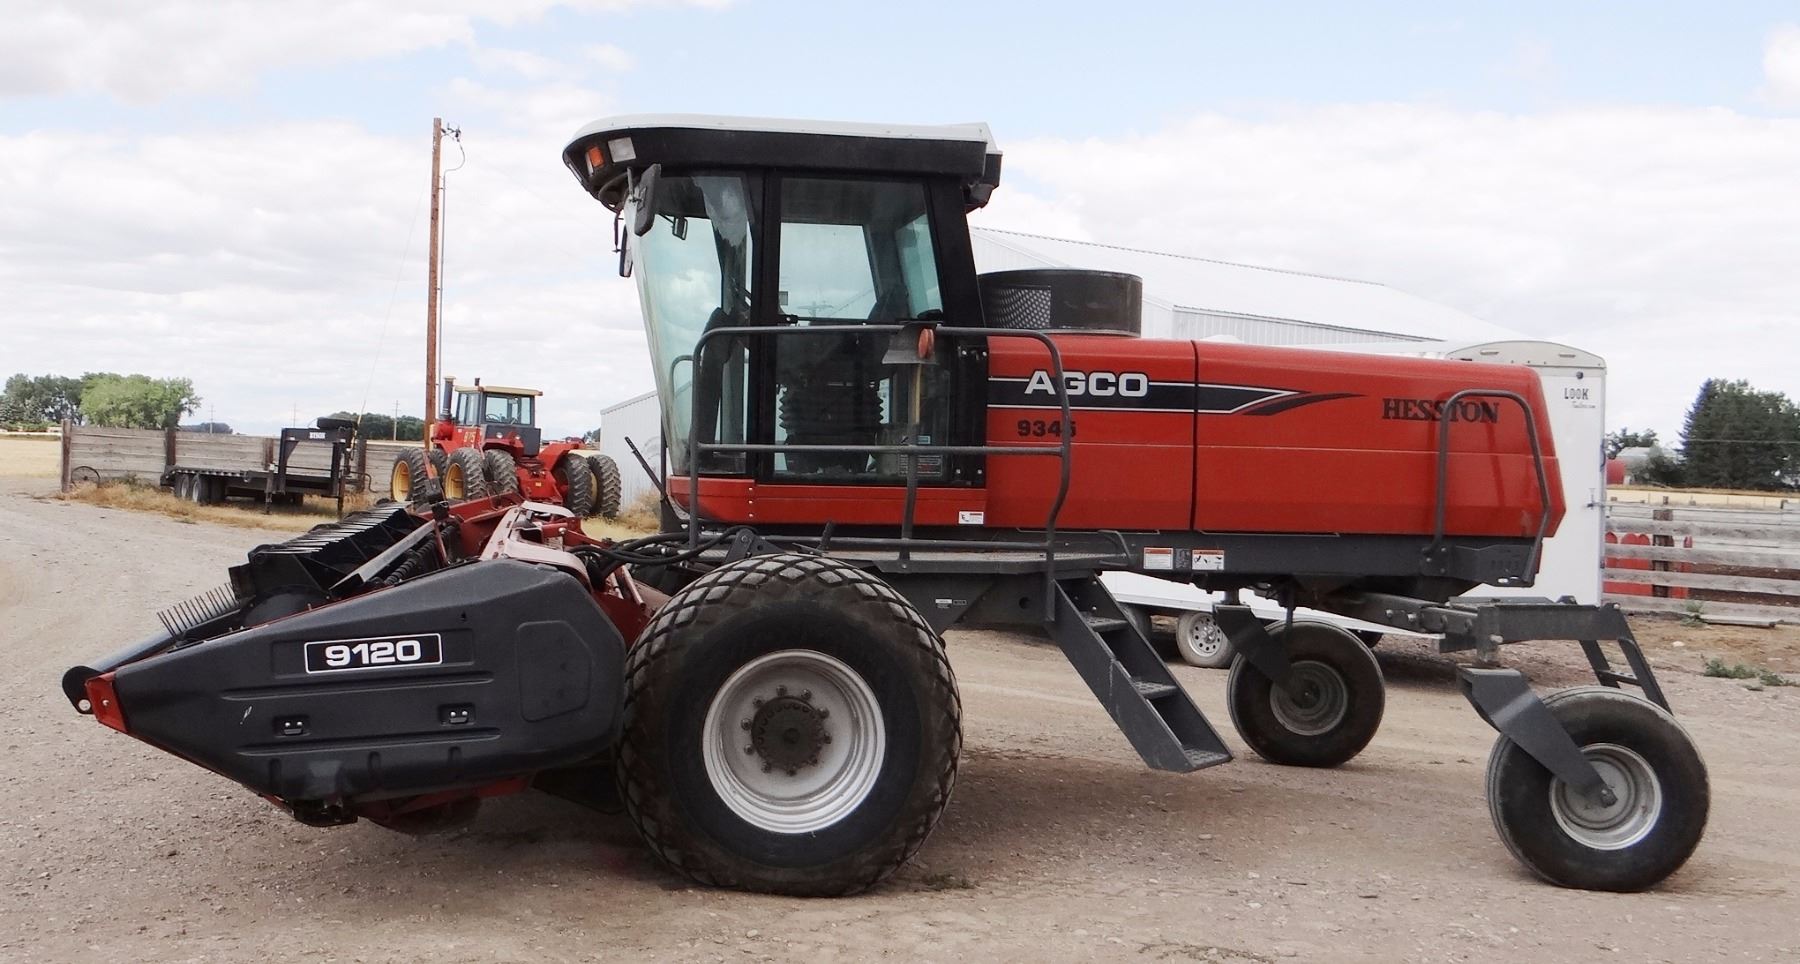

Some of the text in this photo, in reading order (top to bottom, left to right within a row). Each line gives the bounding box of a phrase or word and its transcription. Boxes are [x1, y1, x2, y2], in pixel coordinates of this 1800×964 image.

[1024, 370, 1149, 397] AGCO
[1564, 387, 1589, 400] LOOK
[1382, 398, 1500, 424] HESSTON
[325, 640, 421, 667] 9120
